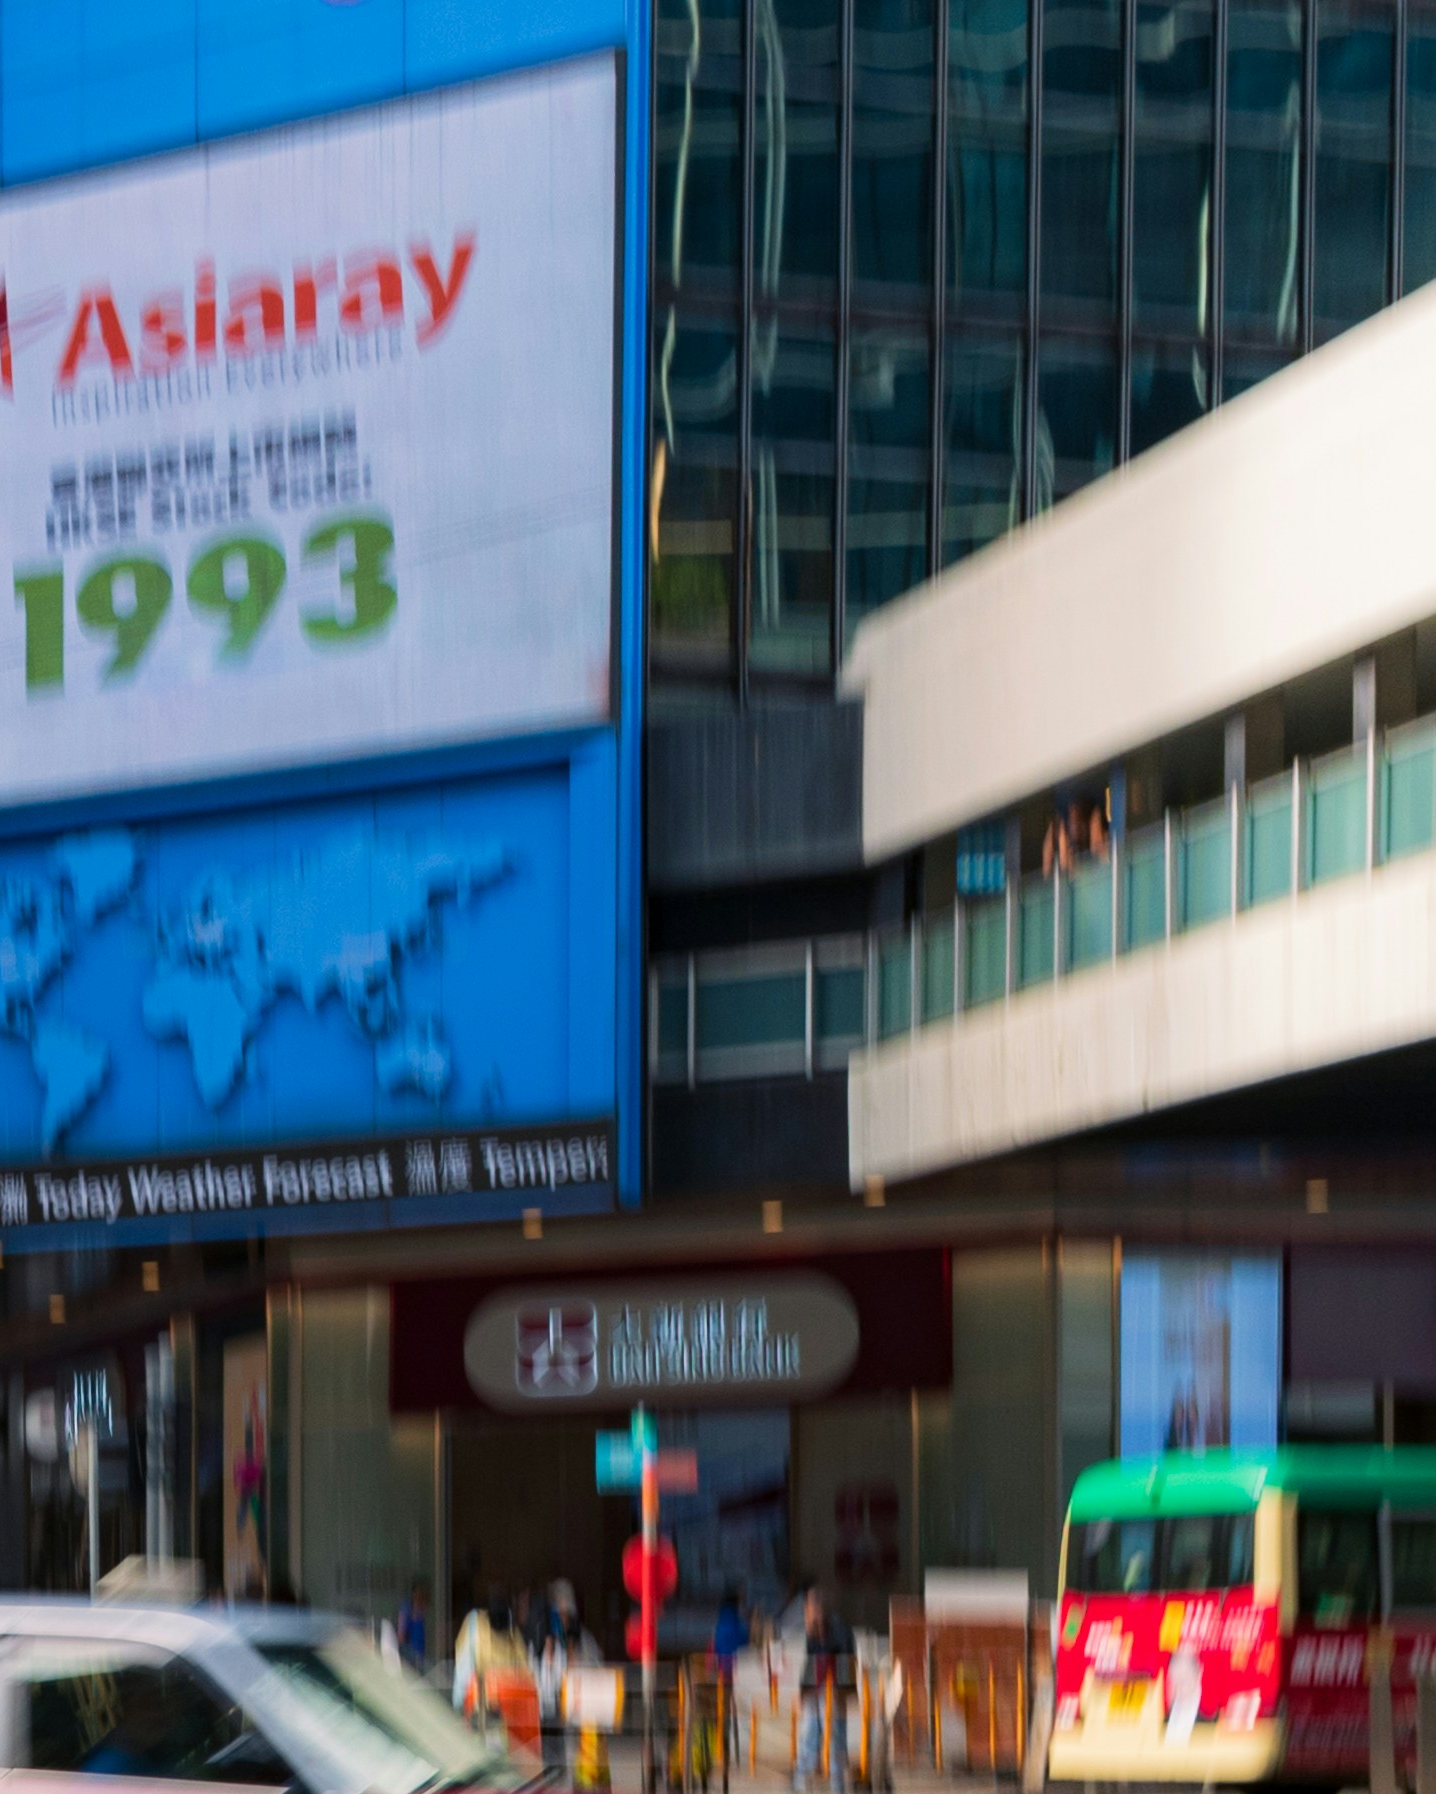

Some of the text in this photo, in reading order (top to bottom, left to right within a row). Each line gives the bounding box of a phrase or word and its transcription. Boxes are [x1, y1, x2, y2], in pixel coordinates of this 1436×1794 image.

[54, 226, 476, 390] Asiaray
[14, 508, 398, 700] 1993
[33, 1168, 123, 1225] Today
[128, 1158, 256, 1216] Weather
[263, 1149, 393, 1206] Forecast
